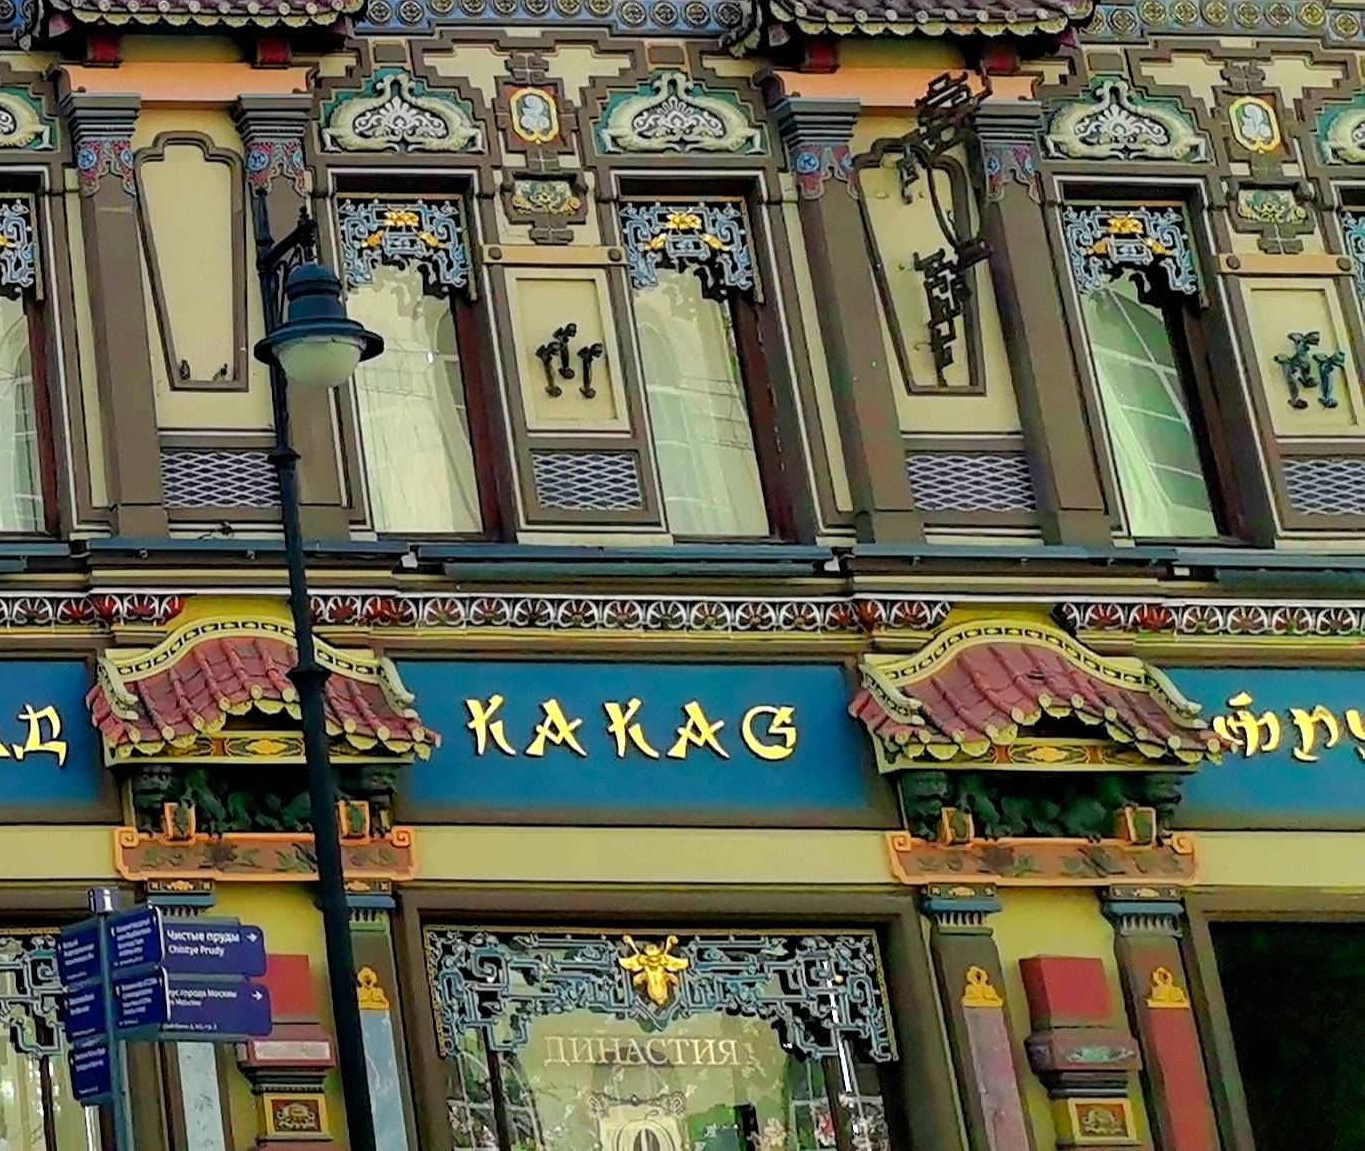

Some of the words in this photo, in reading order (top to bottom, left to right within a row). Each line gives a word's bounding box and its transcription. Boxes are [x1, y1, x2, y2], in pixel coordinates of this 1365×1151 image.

[465, 693, 799, 760] КАКАО
[166, 930, 205, 942] Чистые
[206, 932, 240, 944] пруды
[168, 945, 199, 957] Chistye
[200, 946, 225, 958] Prudy
[543, 1035, 740, 1067] ДИНАСТИЯ
